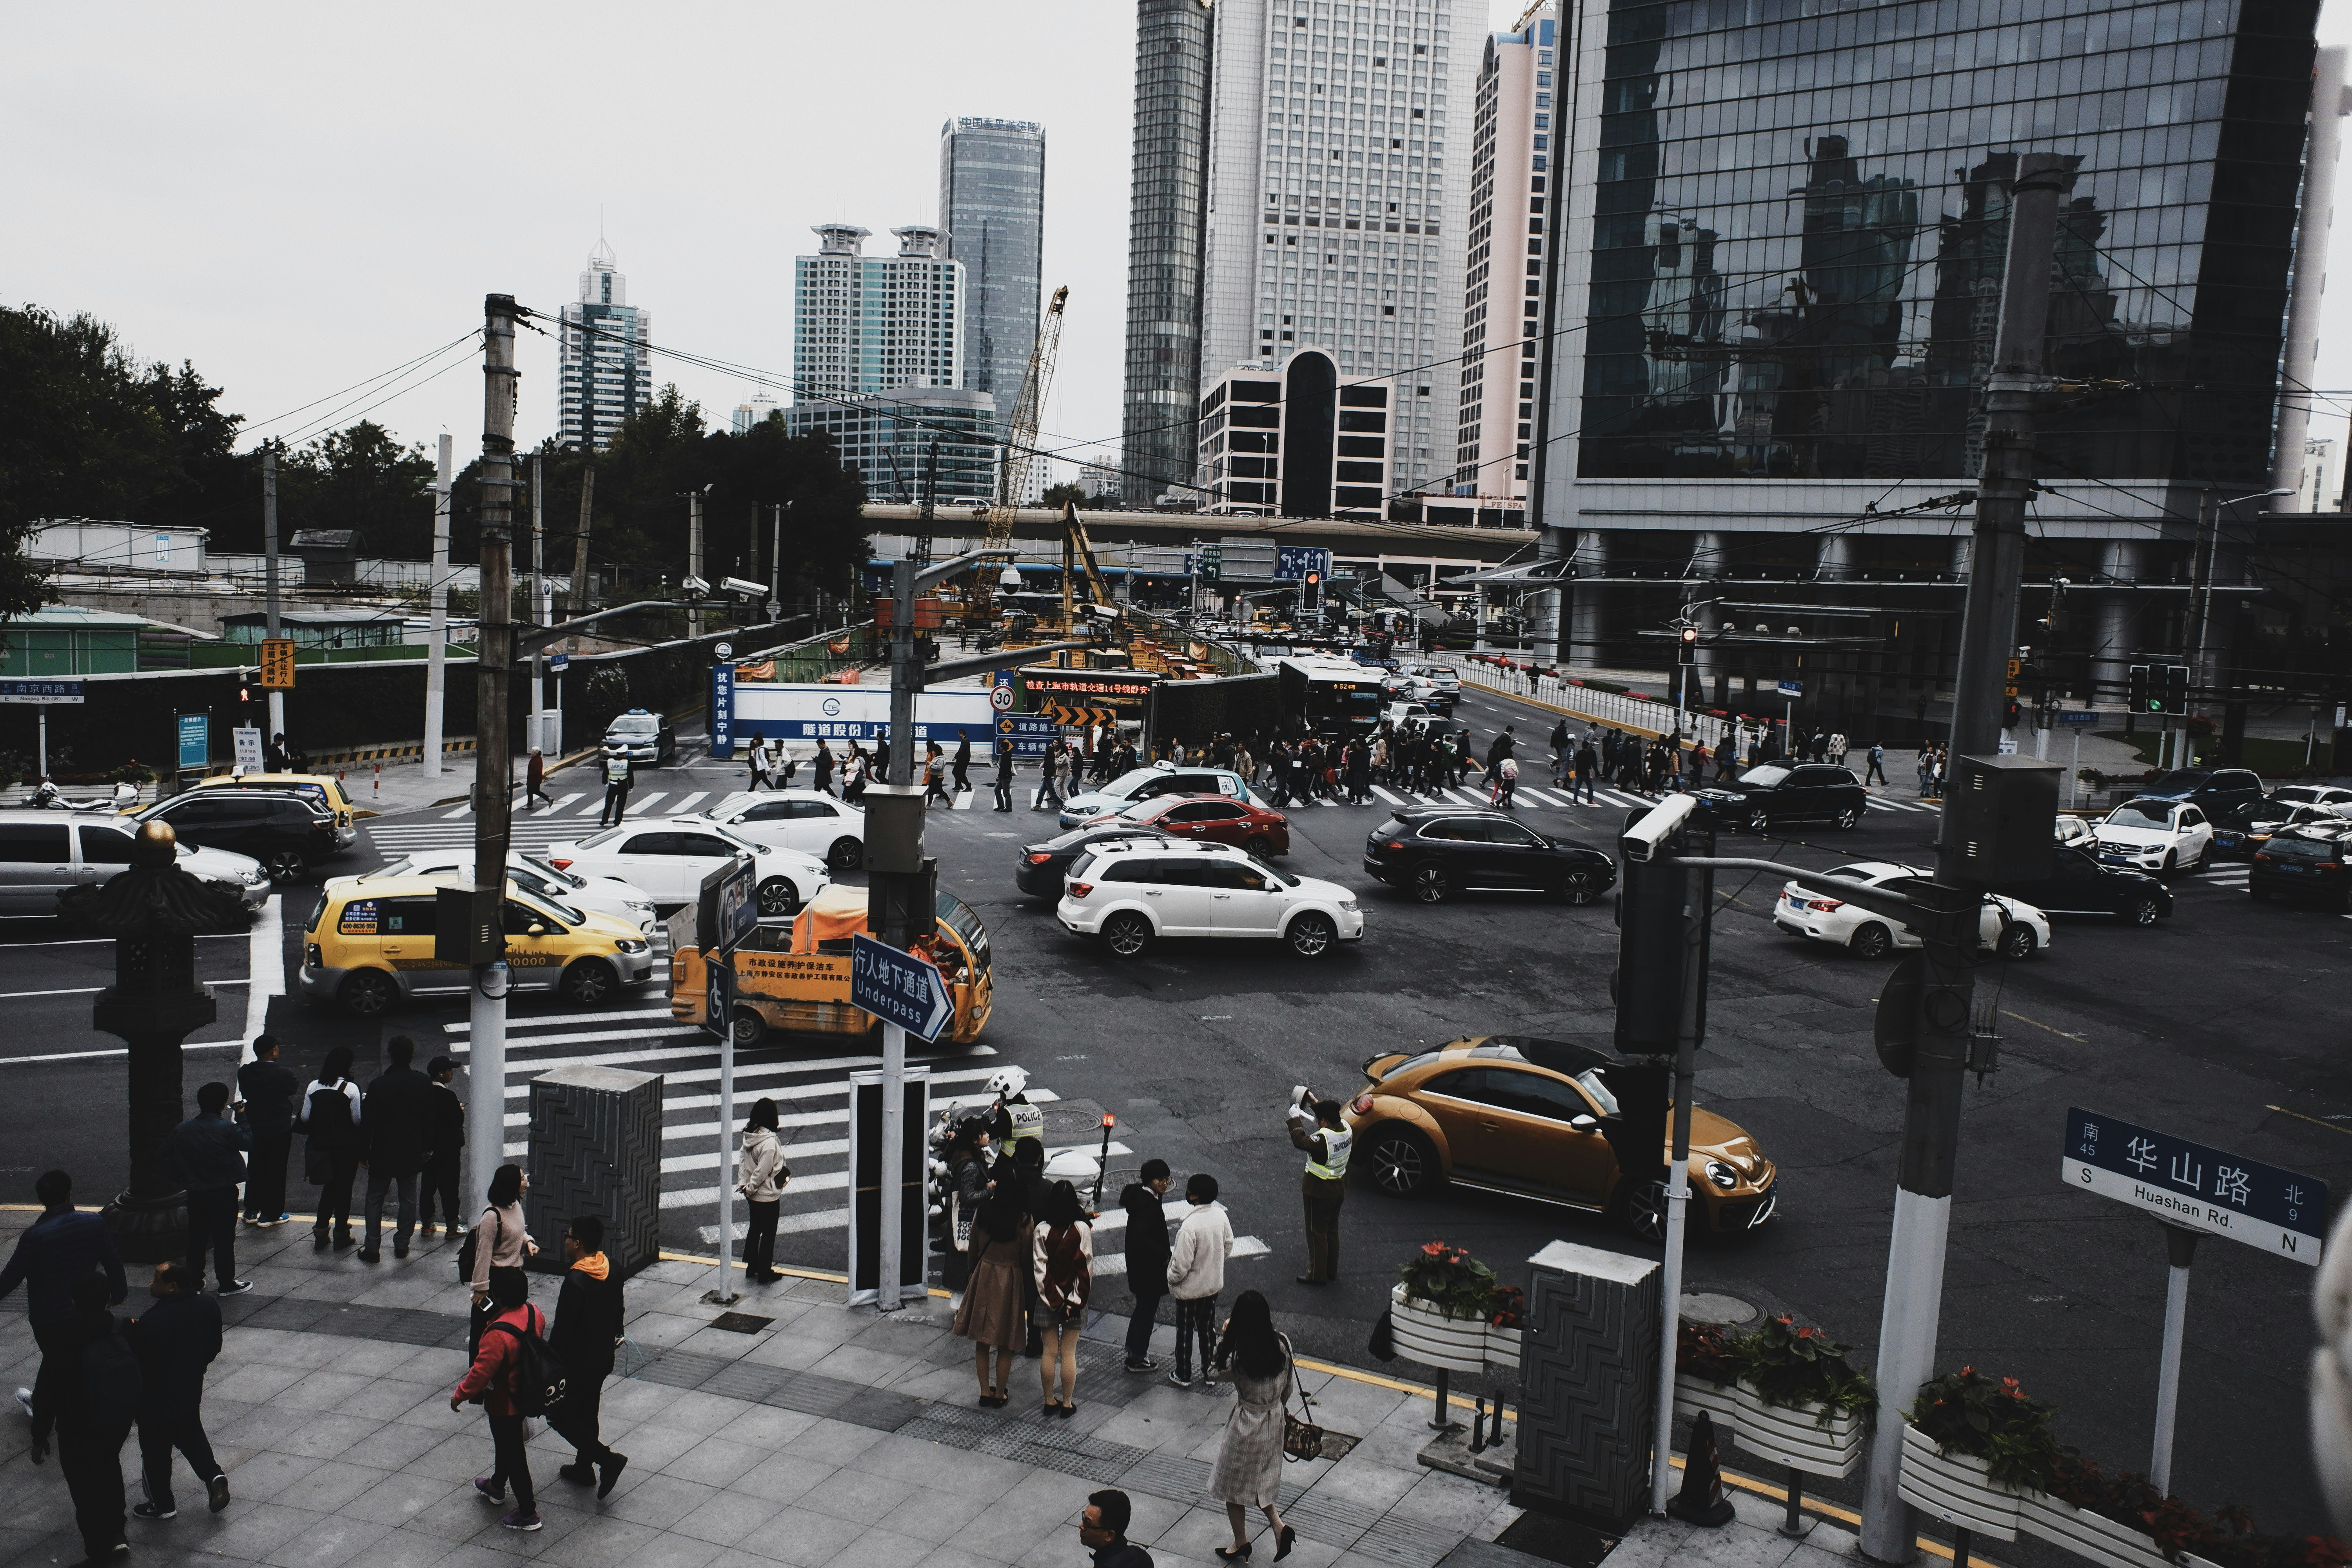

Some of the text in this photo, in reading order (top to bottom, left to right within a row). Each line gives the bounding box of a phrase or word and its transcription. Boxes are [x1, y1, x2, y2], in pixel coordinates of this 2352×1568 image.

[17, 683, 65, 693] 南京西路
[995, 692, 1011, 705] 30
[717, 673, 727, 744] 扰您片刻宁静
[802, 723, 862, 737] 隧道股份
[1018, 722, 1058, 732] 道路施工
[1018, 742, 1053, 752] 车辆慢
[748, 958, 834, 971] 市政设施养护保洁车
[855, 947, 928, 1004] 行人地下通道
[857, 978, 921, 1024] Underpass
[1016, 1111, 1041, 1123] POLICE
[2083, 1122, 2098, 1142] 南
[2080, 1143, 2095, 1156] 45
[2081, 1167, 2092, 1184] S
[2126, 1136, 2251, 1206] 华山路
[2284, 1184, 2303, 1205] 北
[2135, 1185, 2233, 1229] Huashan Rd.
[2289, 1208, 2298, 1221] 9
[2281, 1233, 2297, 1253] N
